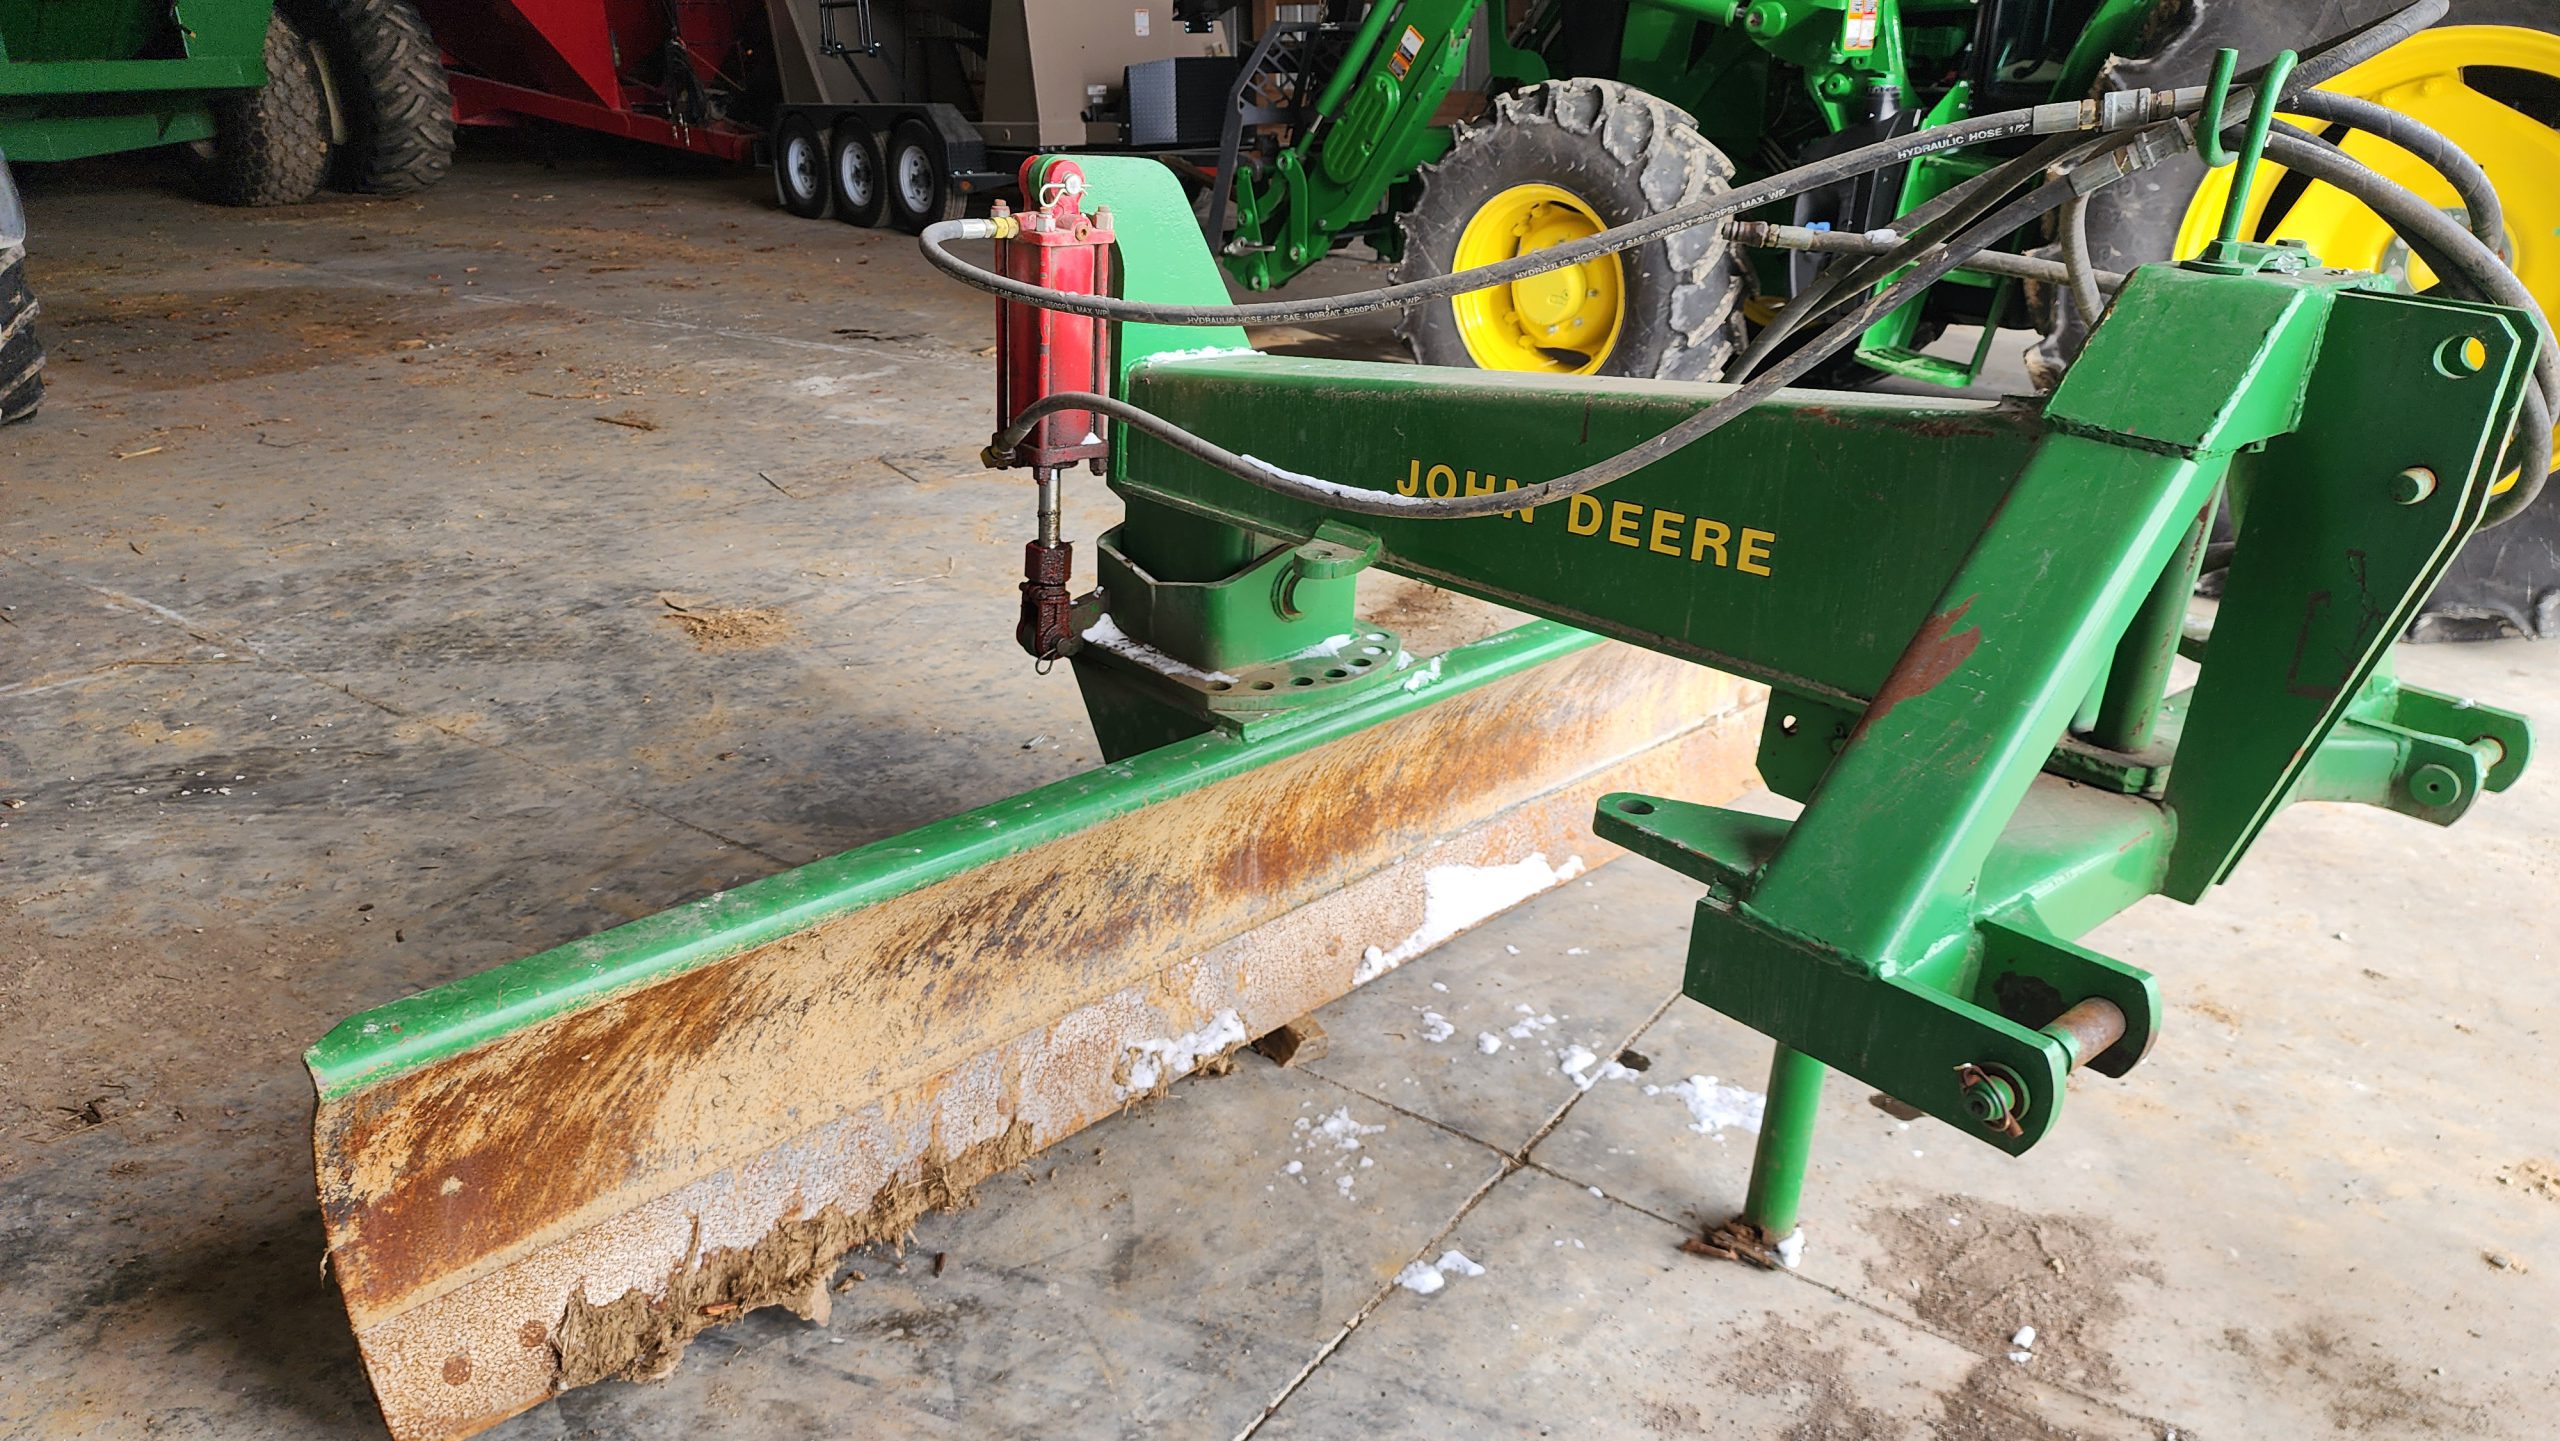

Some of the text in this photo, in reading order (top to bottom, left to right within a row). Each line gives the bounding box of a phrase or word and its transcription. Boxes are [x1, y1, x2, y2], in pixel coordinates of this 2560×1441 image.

[1897, 122, 2030, 159] HYDRAULIC HOSE 1/2"
[1514, 258, 1571, 279] HYDRAULIC
[1574, 249, 1602, 263] HOSE
[1626, 235, 1647, 246] SAE
[1742, 195, 1765, 209] MAX
[1769, 188, 1787, 200] WP
[1077, 305, 1093, 315] MAX
[1187, 314, 1236, 325] HYDRAULIC
[1283, 312, 1301, 322] SAE
[1343, 303, 1380, 316] 3500PSI
[1405, 295, 1421, 305] WP
[1567, 492, 1776, 577] DEERE
